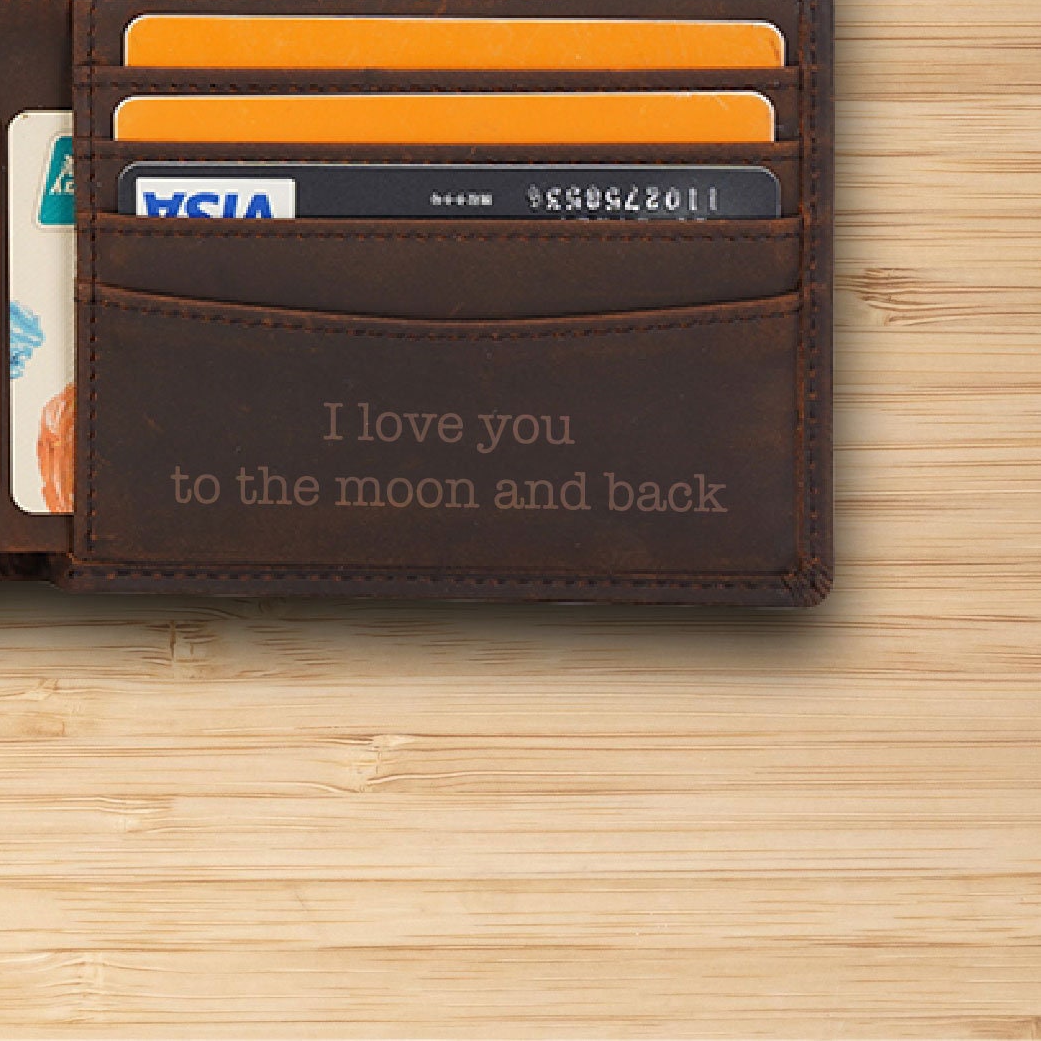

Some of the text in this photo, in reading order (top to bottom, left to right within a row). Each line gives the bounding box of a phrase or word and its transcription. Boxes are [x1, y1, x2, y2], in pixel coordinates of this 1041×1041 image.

[143, 191, 274, 218] VISA
[323, 402, 576, 454] I love you
[170, 465, 729, 514] to the moon and back
